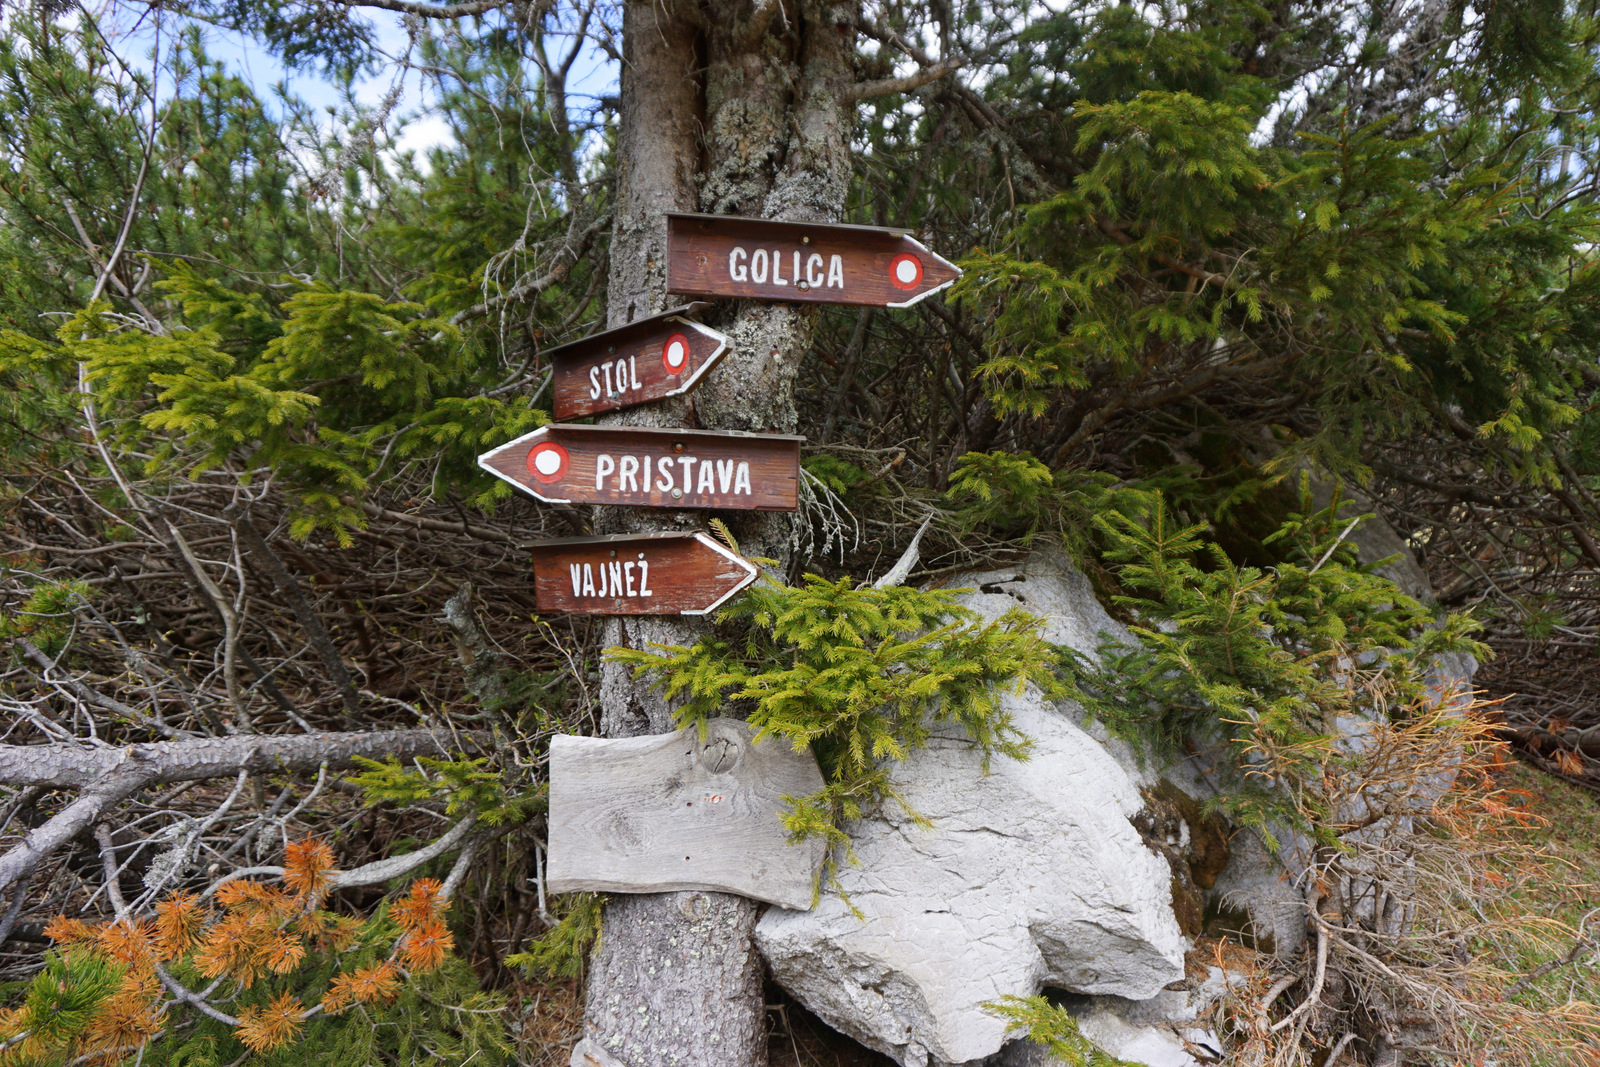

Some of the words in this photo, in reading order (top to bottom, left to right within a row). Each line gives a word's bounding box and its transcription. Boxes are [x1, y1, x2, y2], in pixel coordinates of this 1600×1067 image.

[729, 246, 844, 289] GOLICA
[589, 355, 642, 400] STOL
[595, 454, 751, 495] PRISTAVA
